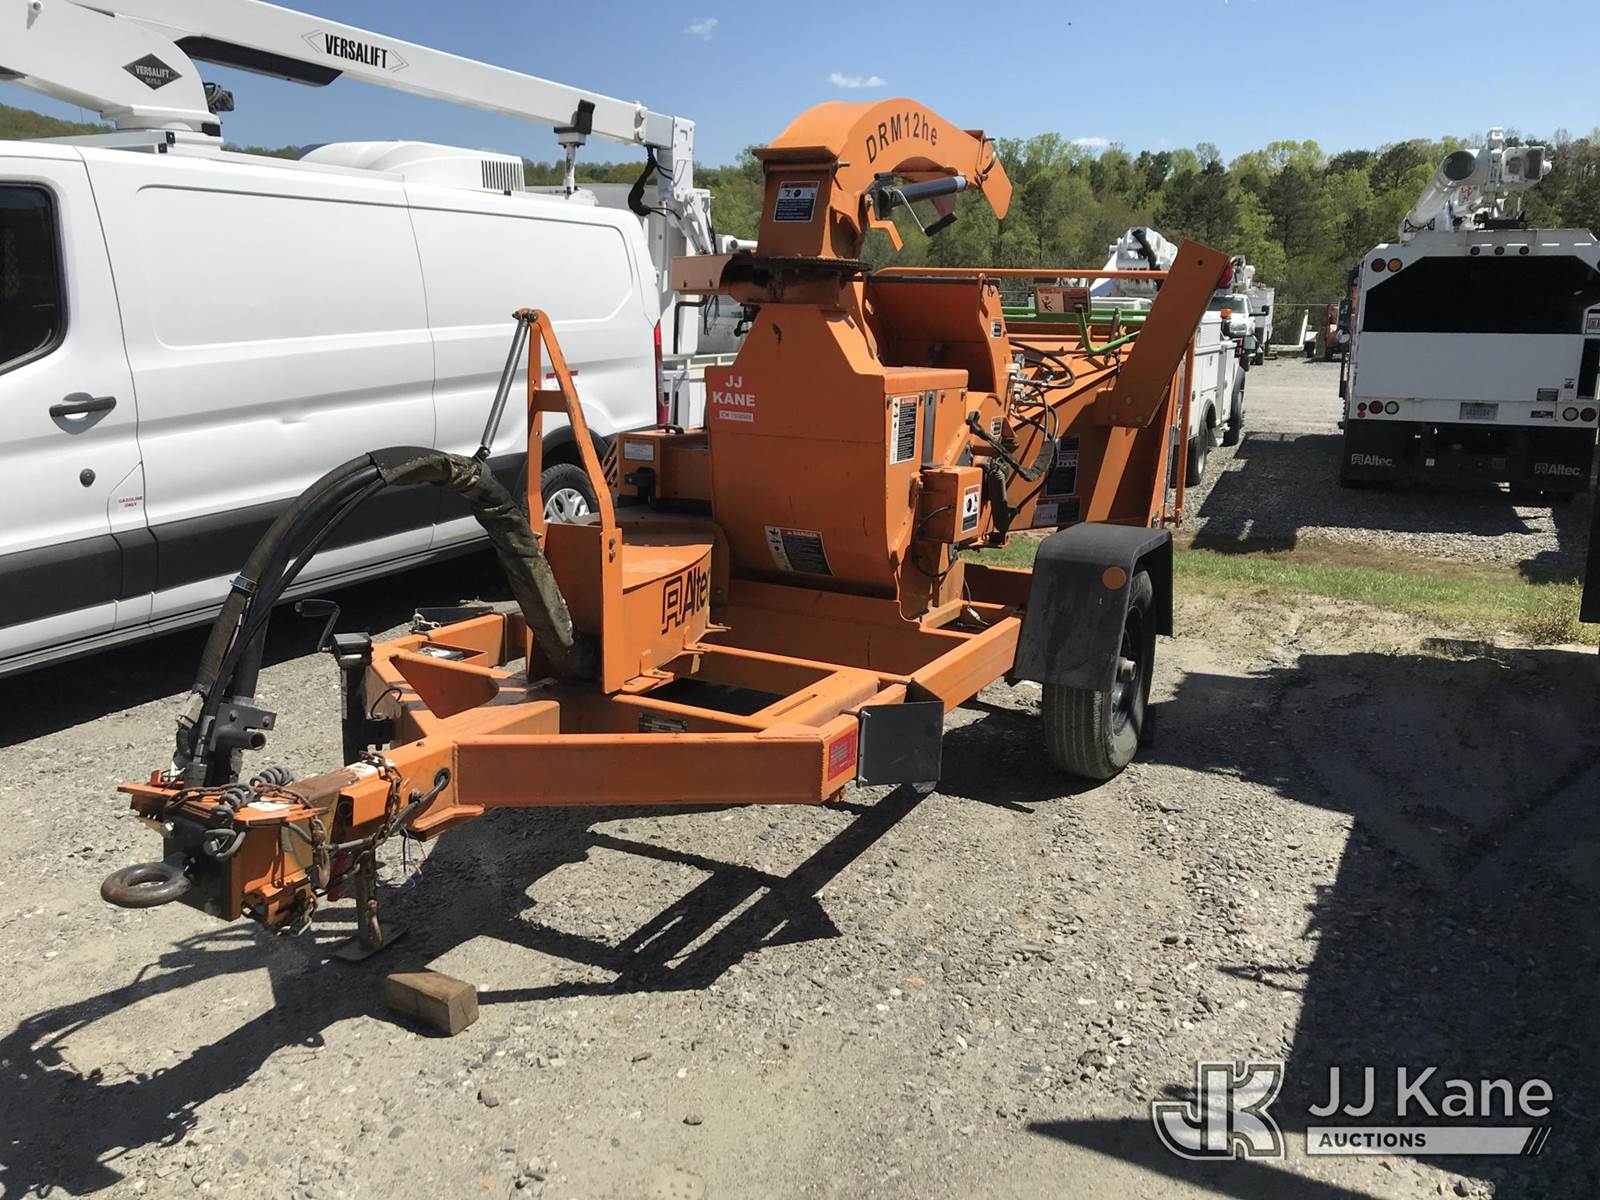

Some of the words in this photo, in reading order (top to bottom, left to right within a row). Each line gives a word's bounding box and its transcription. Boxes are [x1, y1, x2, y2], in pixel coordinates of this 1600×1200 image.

[325, 33, 388, 69] VERSALIFT
[134, 64, 170, 78] VERSALIFT
[866, 112, 938, 163] DRM12he
[725, 375, 743, 388] JJ
[712, 391, 756, 407] KANE
